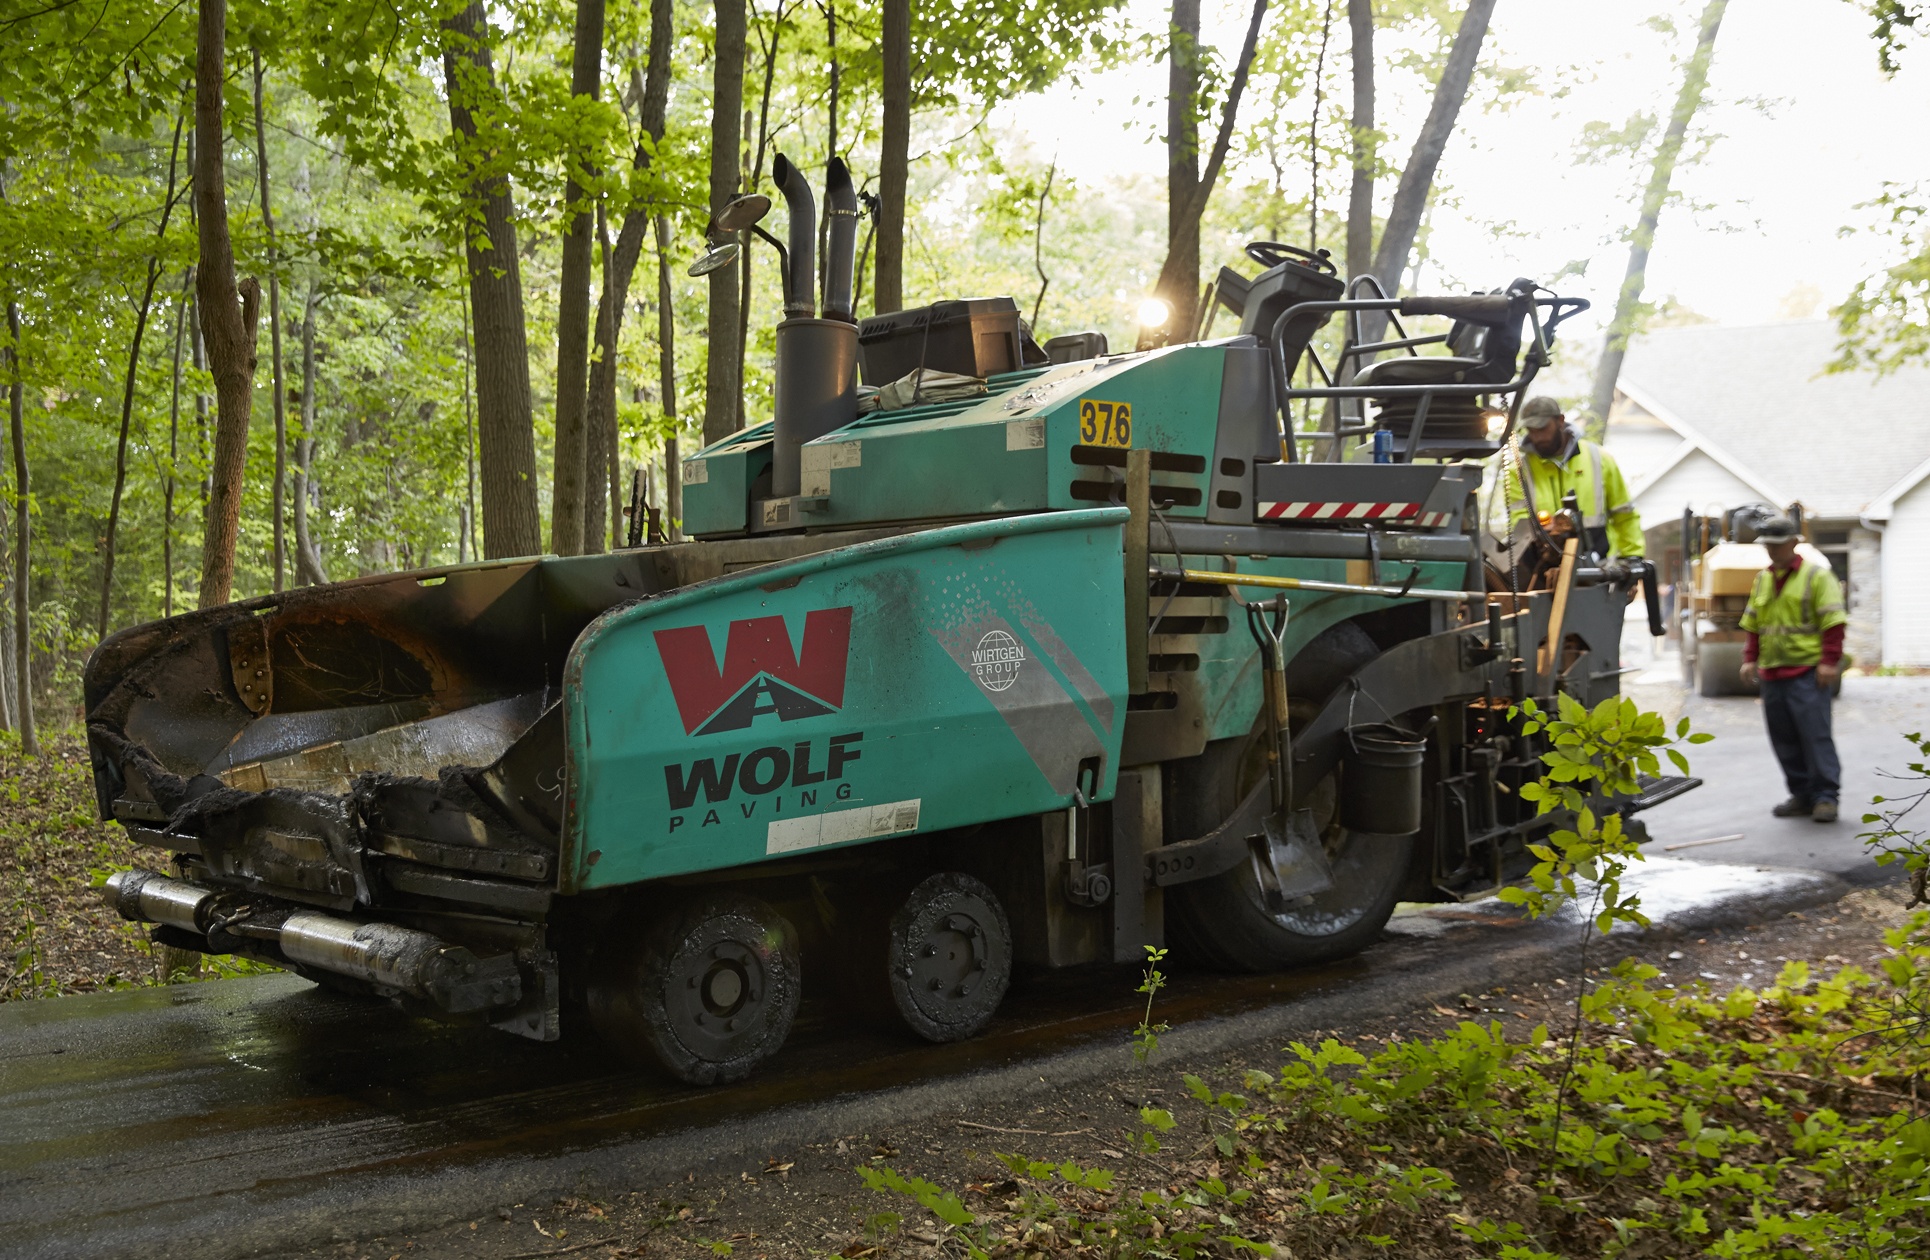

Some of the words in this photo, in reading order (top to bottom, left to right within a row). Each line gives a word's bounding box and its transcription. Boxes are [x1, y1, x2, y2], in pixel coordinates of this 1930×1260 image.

[1081, 402, 1130, 445] 376
[971, 646, 1024, 663] WIRTGEN
[976, 662, 1021, 675] GROUP
[664, 732, 864, 810] WOLF
[669, 783, 851, 834] PAVING
